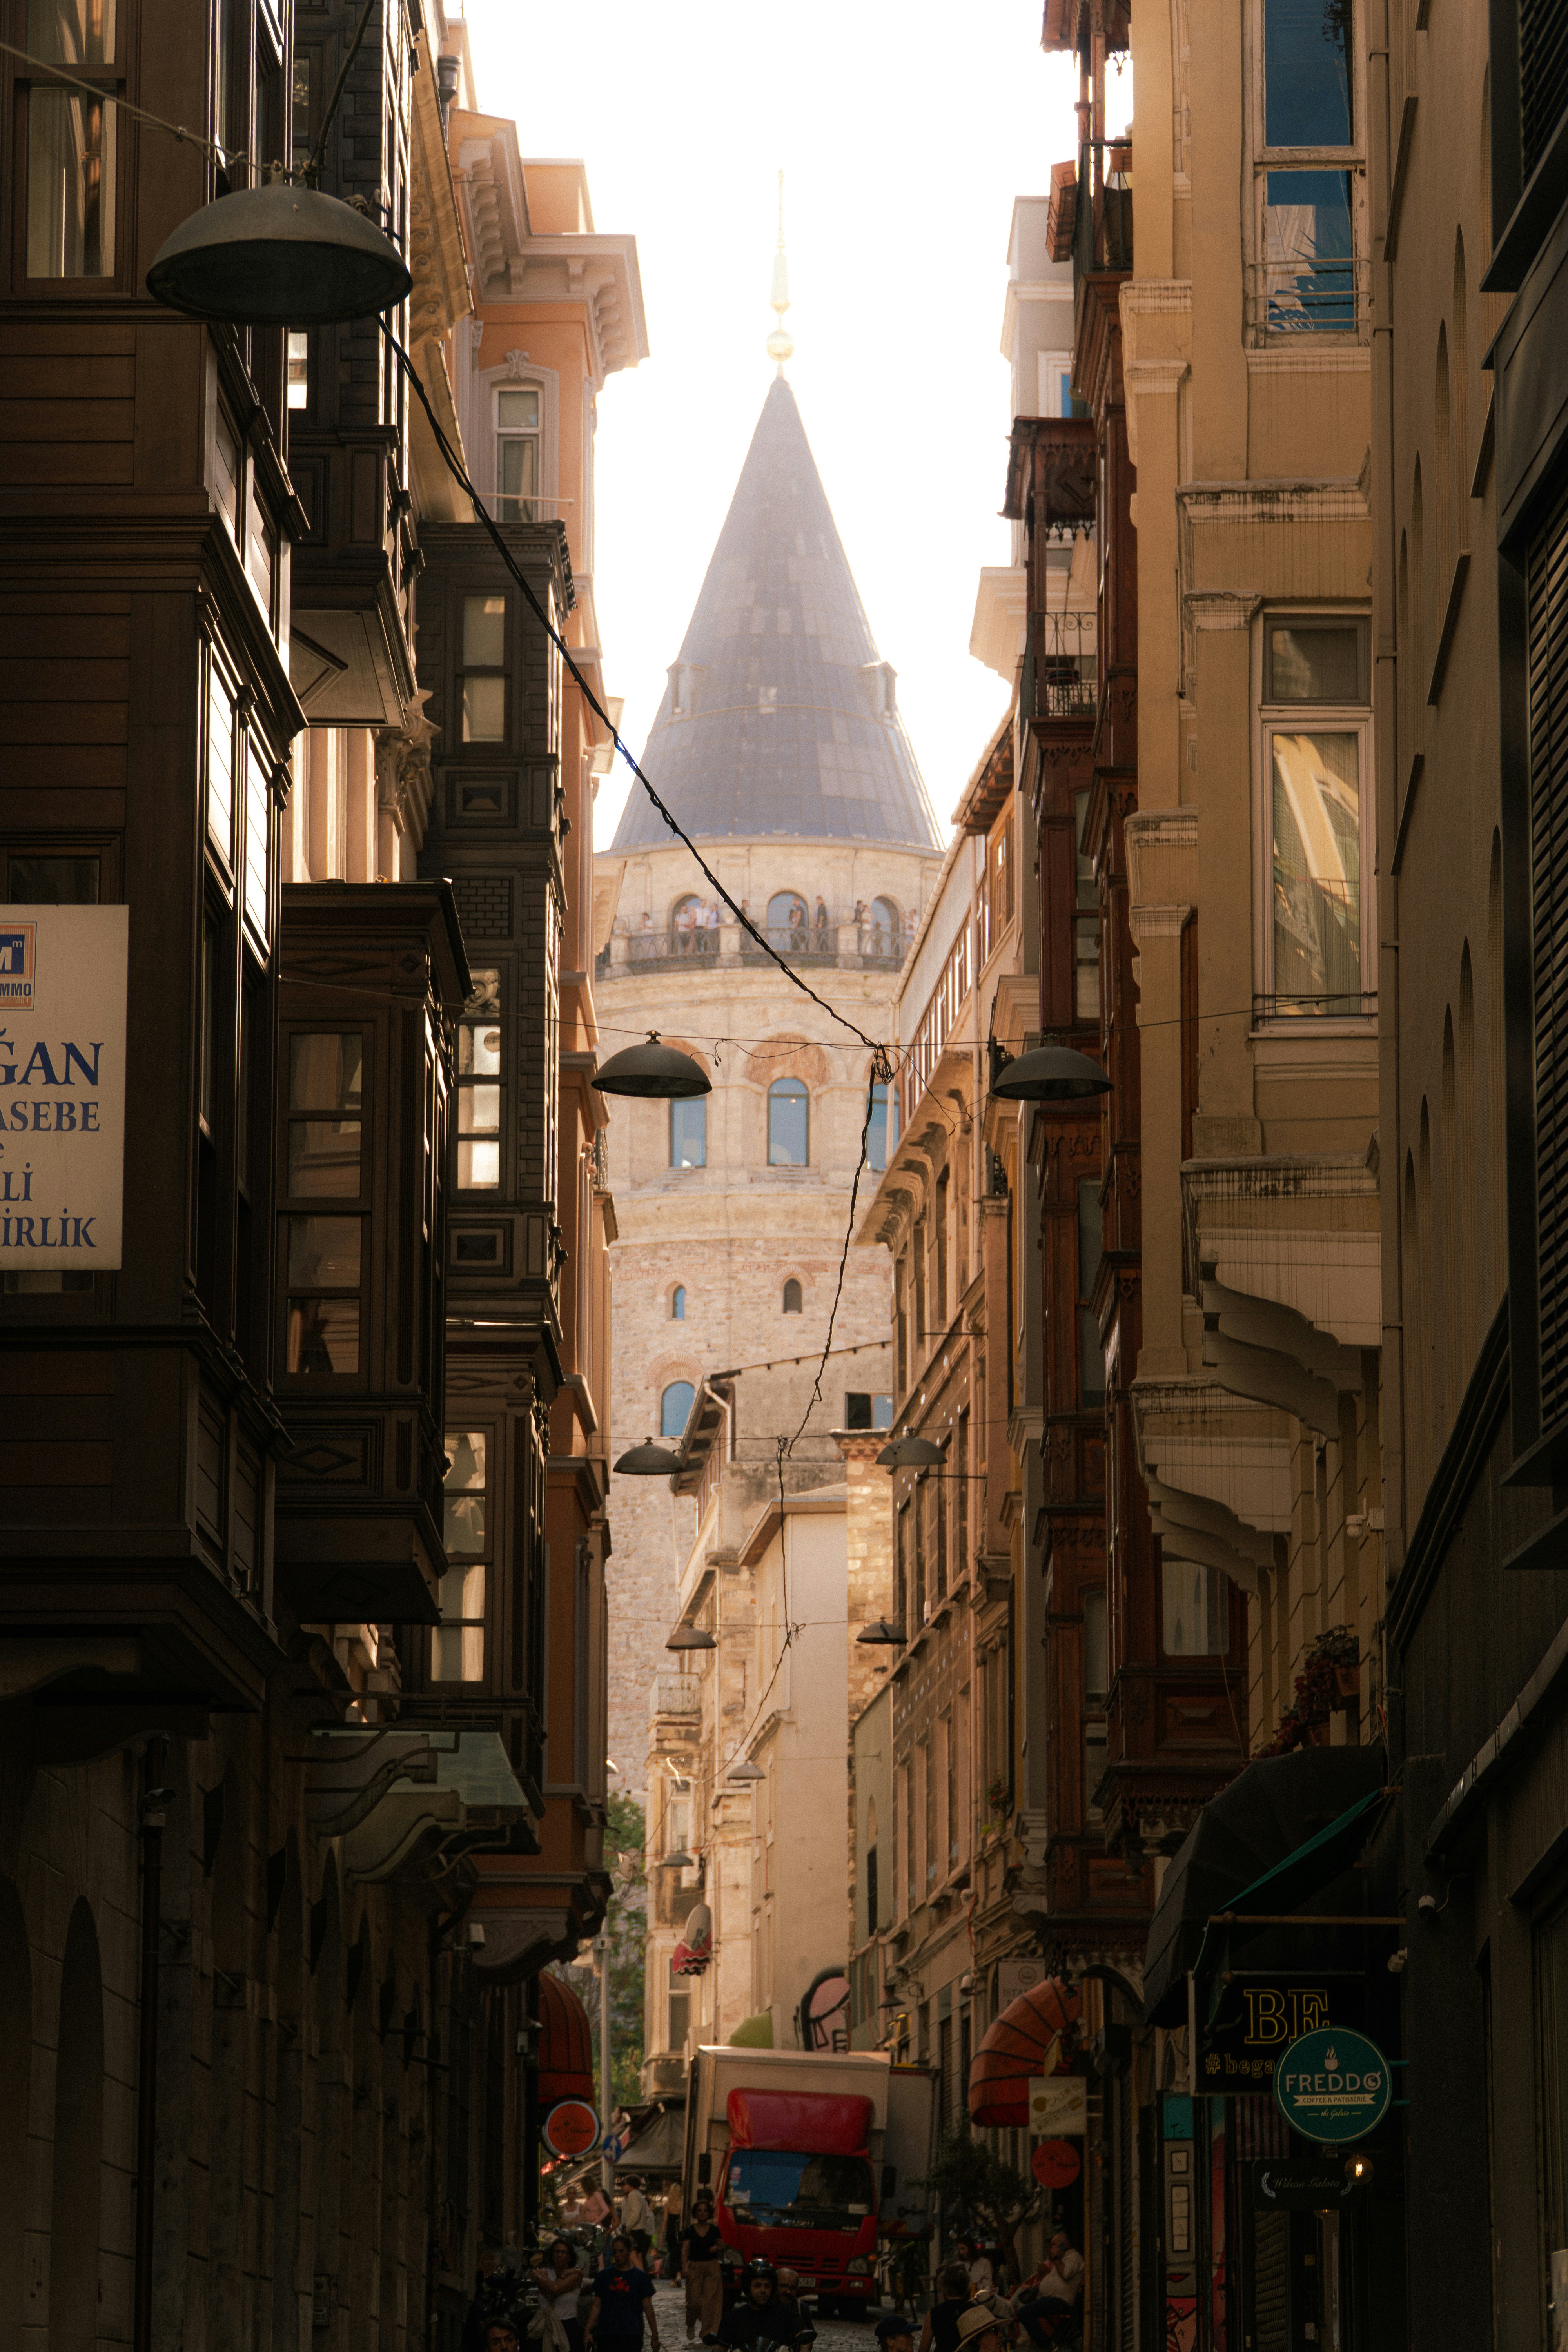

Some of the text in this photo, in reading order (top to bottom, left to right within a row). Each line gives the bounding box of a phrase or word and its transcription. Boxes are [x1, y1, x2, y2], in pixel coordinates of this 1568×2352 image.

[0, 1101, 100, 1132] SEBE
[0, 1162, 34, 1201] Lİ
[0, 1207, 97, 1248] İRLİK
[1286, 2071, 1381, 2093] FREDDO
[1320, 2108, 1329, 2117] the
[1273, 2176, 1341, 2189] Wilson Galata
